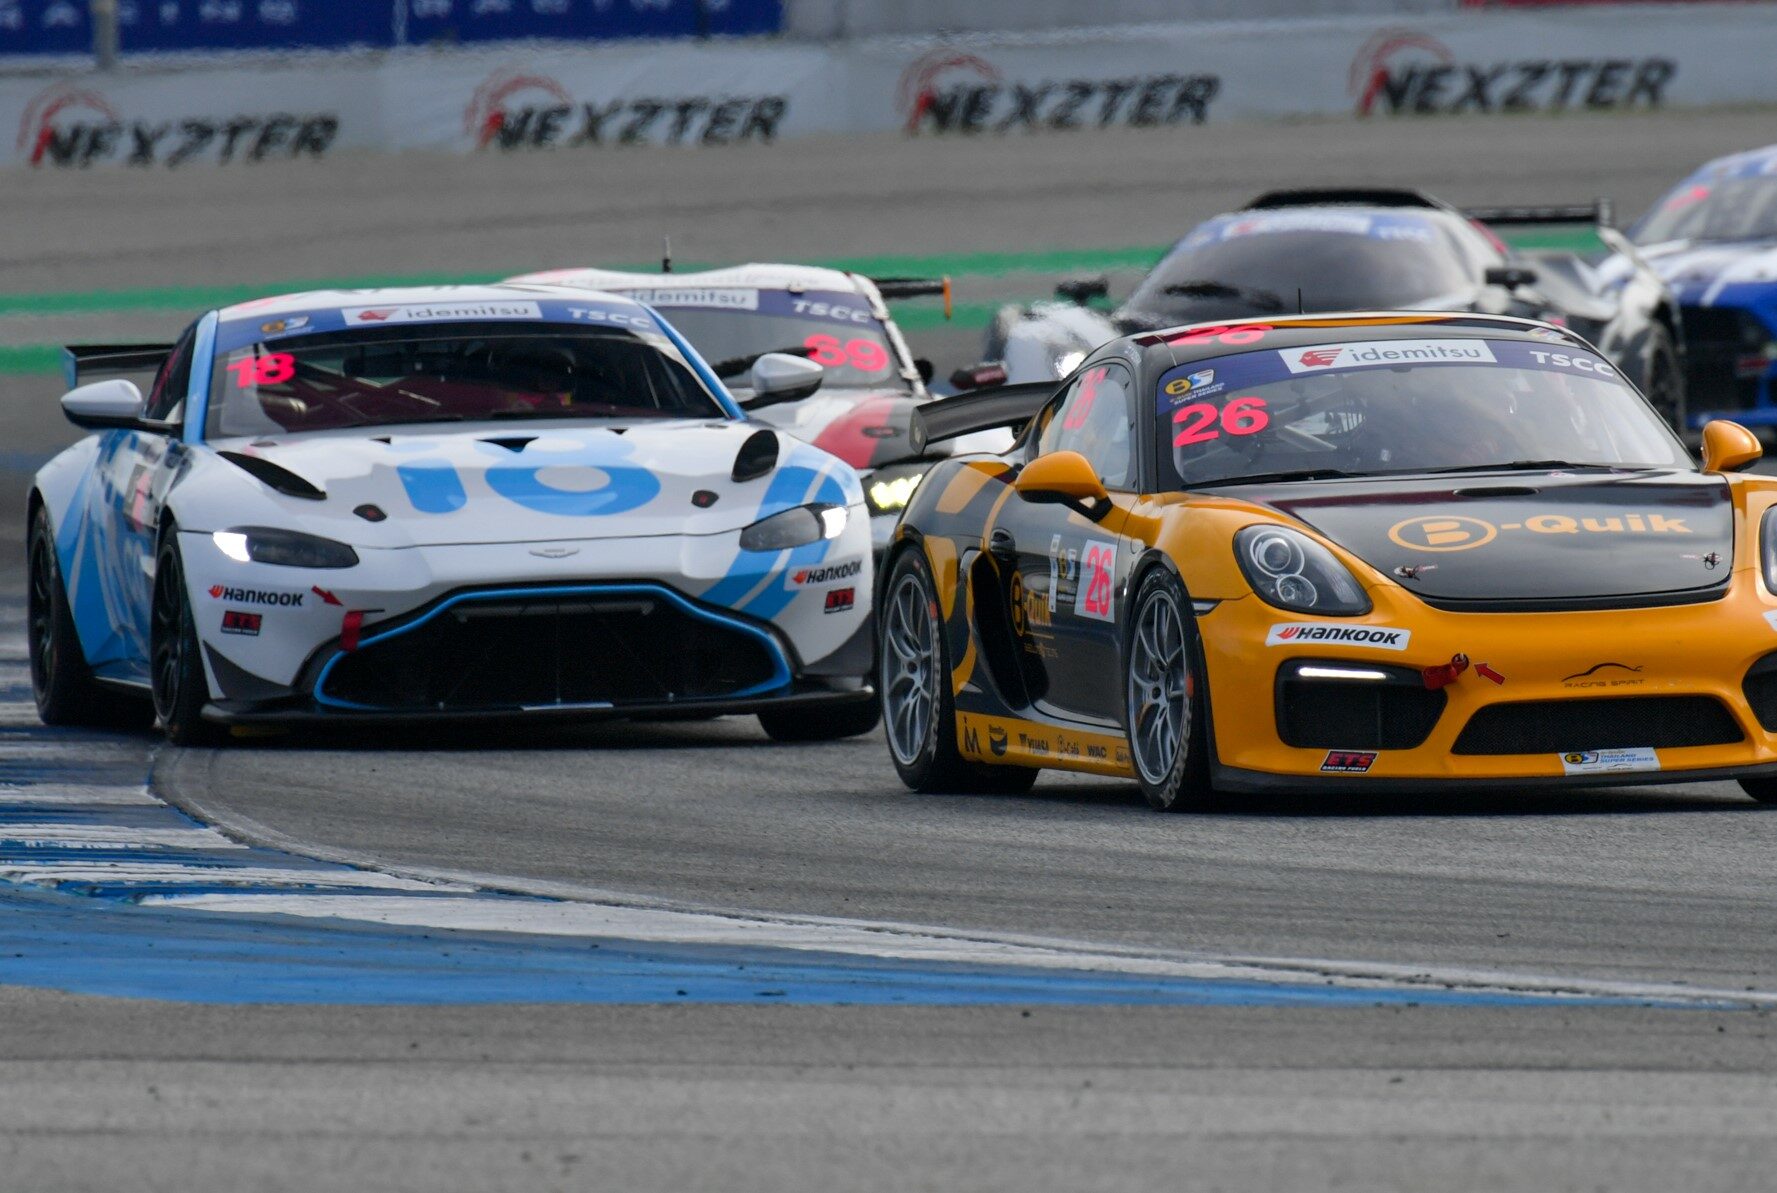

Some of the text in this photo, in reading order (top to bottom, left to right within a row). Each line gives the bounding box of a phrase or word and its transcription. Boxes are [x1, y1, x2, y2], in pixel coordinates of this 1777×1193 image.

[1357, 56, 1677, 118] NEXZTER
[908, 74, 1221, 138] NEXZTER
[476, 94, 790, 149] NEXZTER
[406, 306, 530, 320] idemitsu
[567, 308, 650, 328] TSCC
[793, 300, 871, 323] TSCC
[1169, 324, 1273, 346] 26
[802, 333, 890, 372] 69
[1350, 345, 1481, 362] idemitsu
[1528, 351, 1615, 377] TSCC
[227, 352, 295, 389] 18
[1172, 397, 1269, 448] 26
[1084, 545, 1113, 617] 26
[223, 587, 304, 607] HANKOOK
[1296, 627, 1401, 645] HANKOOK
[1327, 752, 1375, 767] ETS
